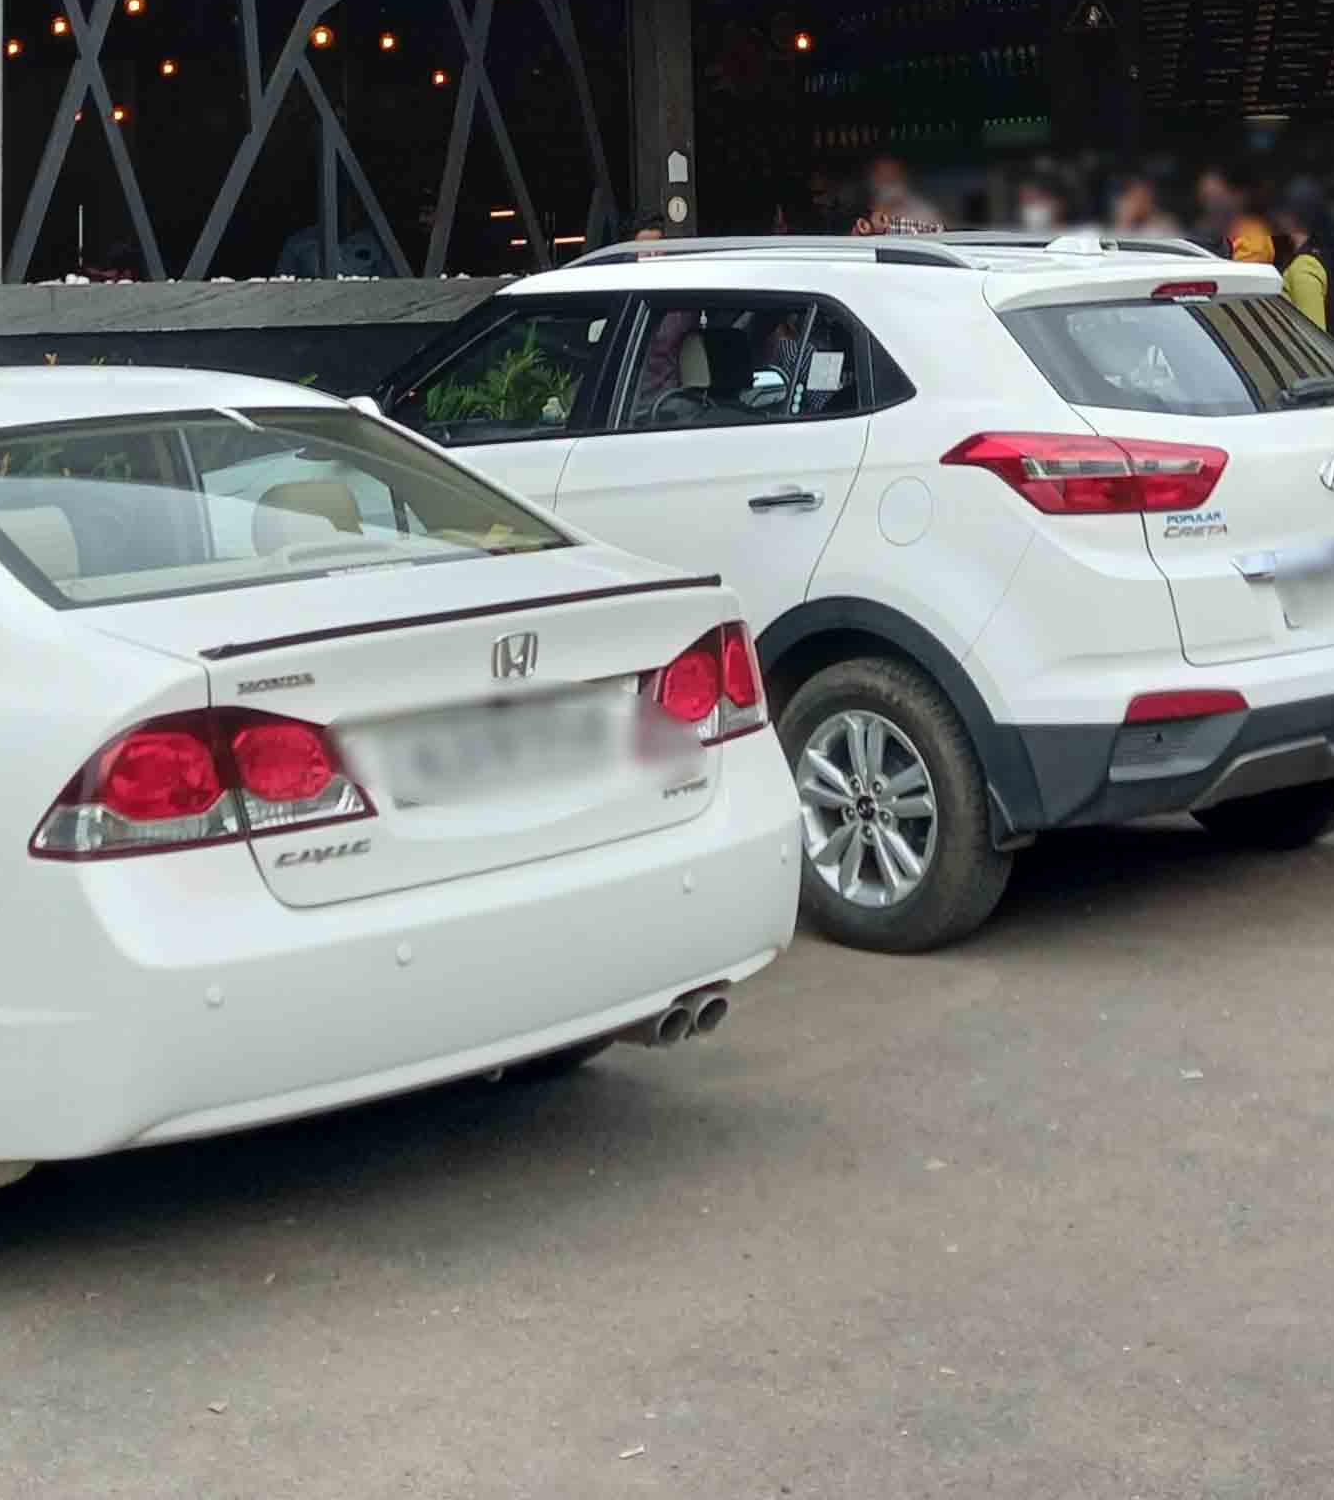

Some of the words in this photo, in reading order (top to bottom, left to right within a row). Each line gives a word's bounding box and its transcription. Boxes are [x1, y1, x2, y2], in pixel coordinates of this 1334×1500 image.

[1163, 524, 1228, 540] CRETA
[237, 672, 316, 695] HONDA
[275, 838, 371, 867] CIVIC
